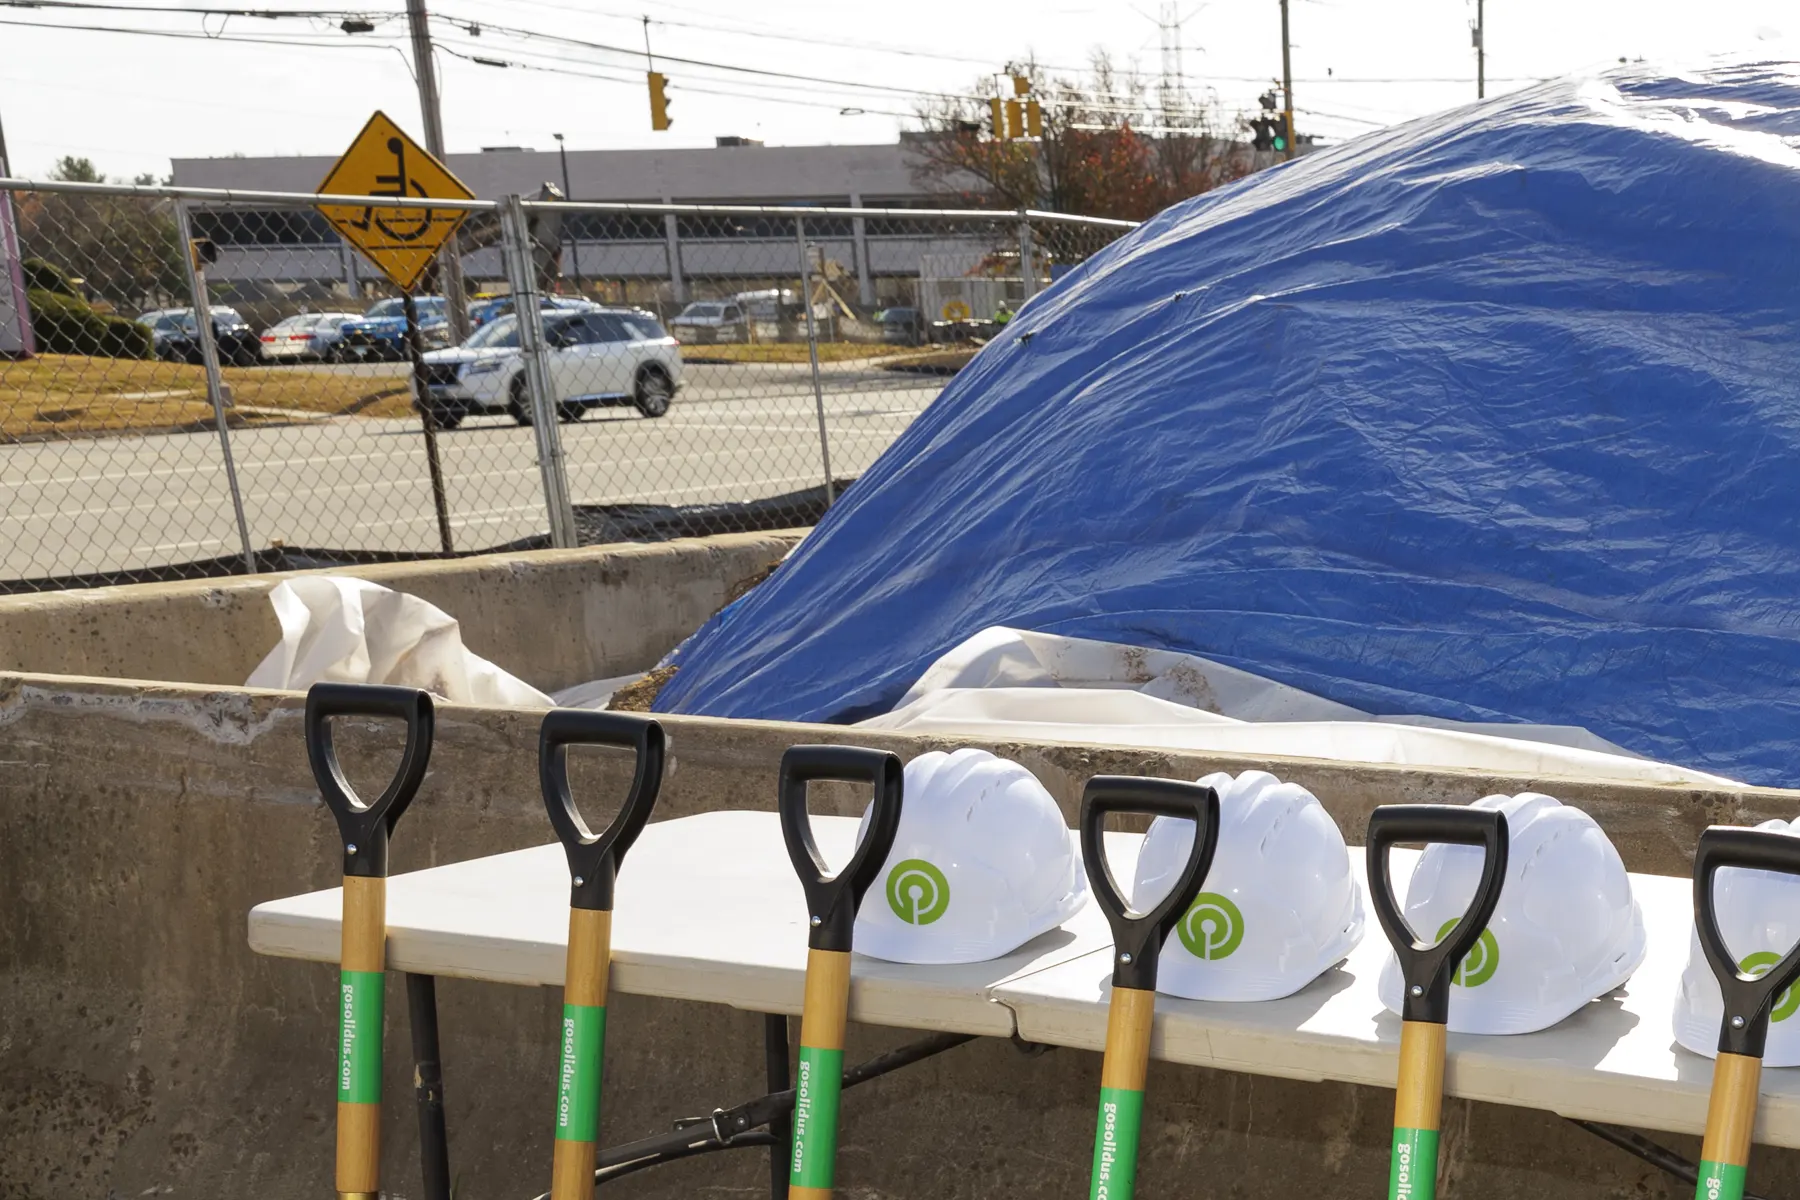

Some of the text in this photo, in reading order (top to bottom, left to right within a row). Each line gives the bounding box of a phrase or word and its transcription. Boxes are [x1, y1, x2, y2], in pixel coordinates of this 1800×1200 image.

[342, 984, 356, 1090] gosolidus.com
[560, 1018, 576, 1127] gosolidus.com
[794, 1061, 811, 1172] gosolidus.com
